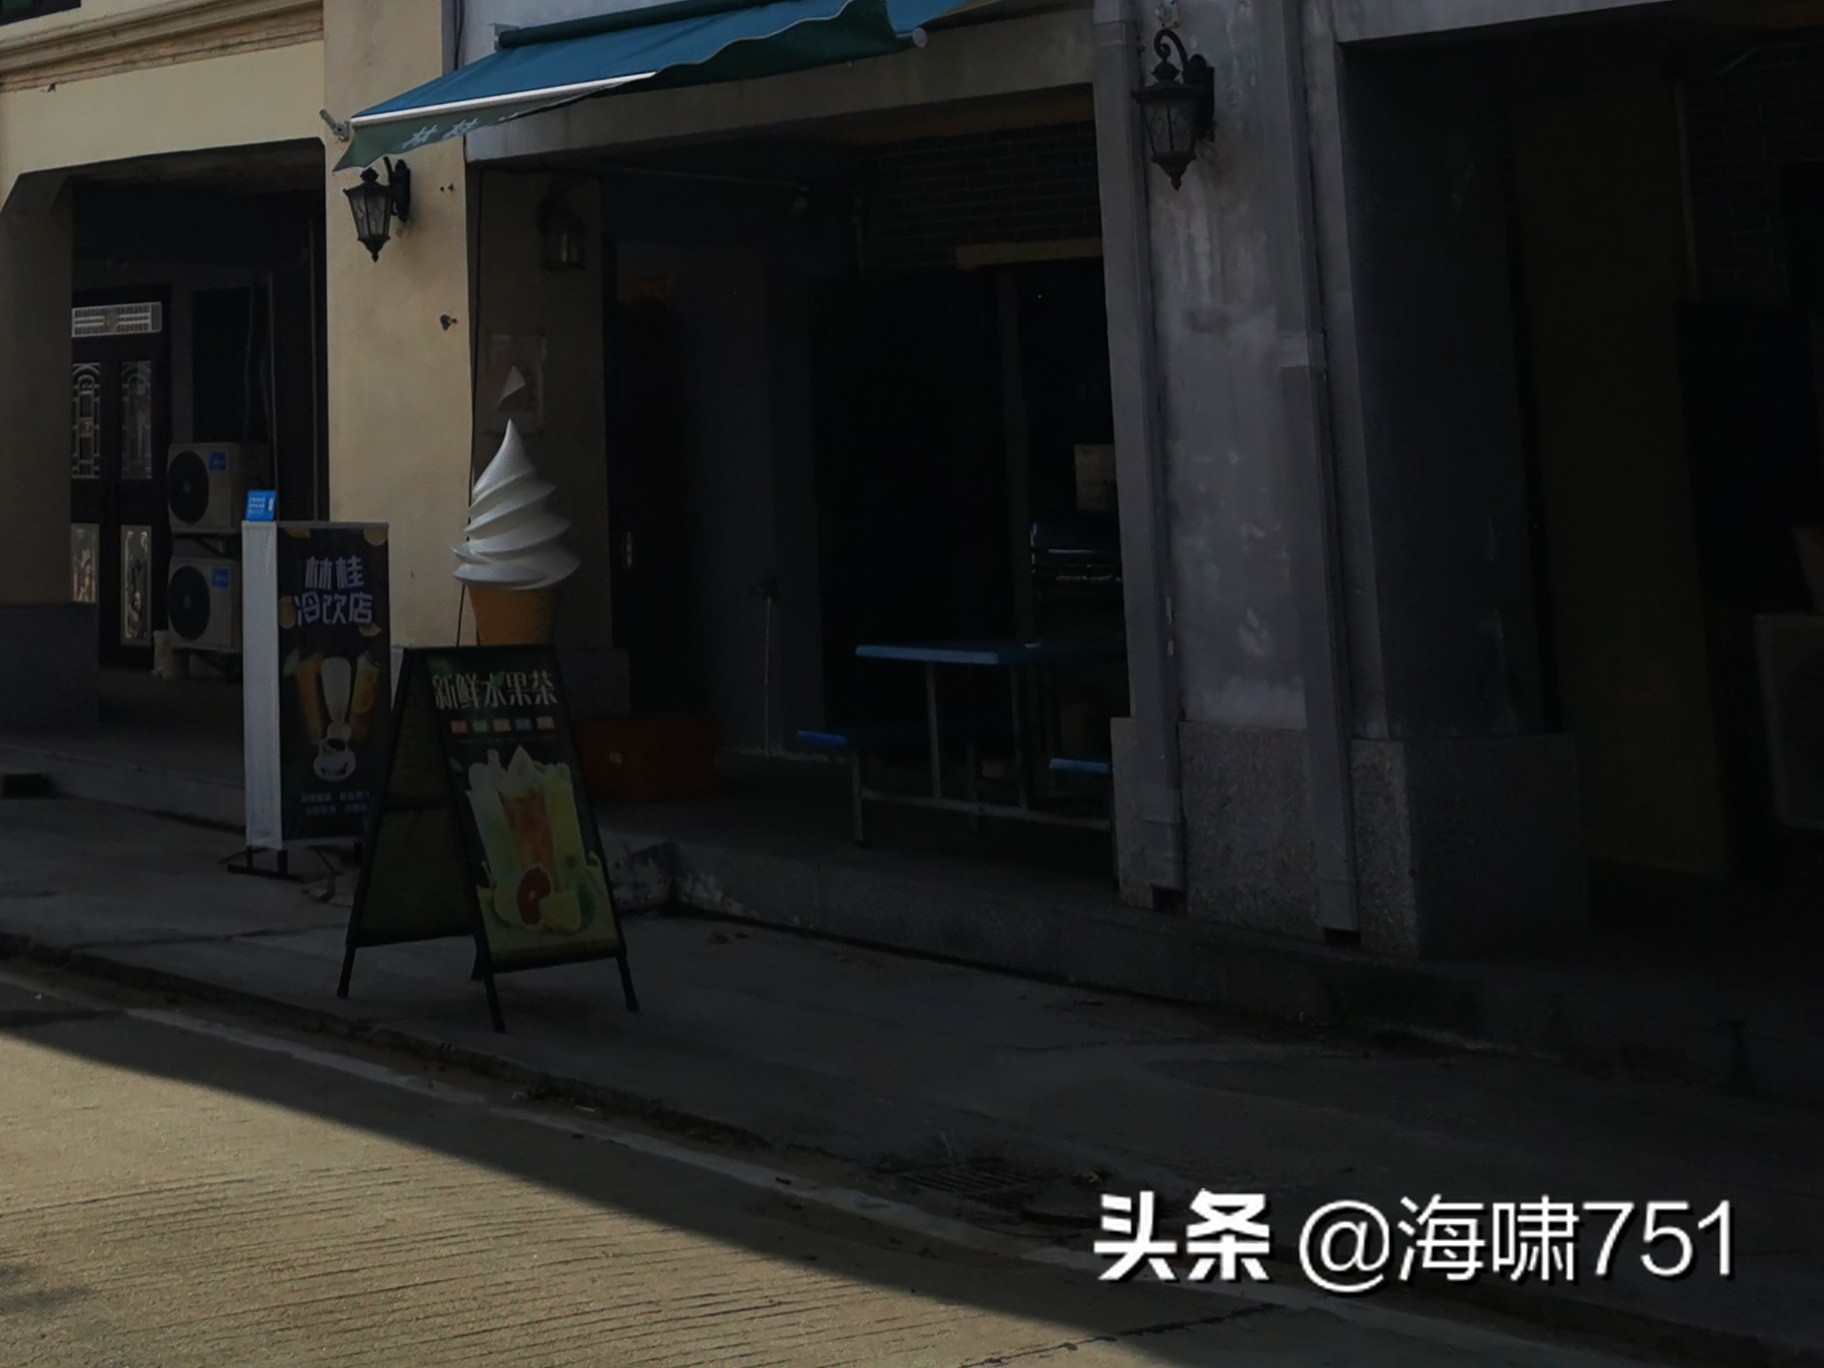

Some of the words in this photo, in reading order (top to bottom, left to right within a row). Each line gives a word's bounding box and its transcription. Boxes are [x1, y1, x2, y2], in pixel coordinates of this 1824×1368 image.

[304, 555, 365, 590] 林桂
[293, 589, 374, 628] 冷饮店
[432, 670, 559, 710] 新鲜水果茶
